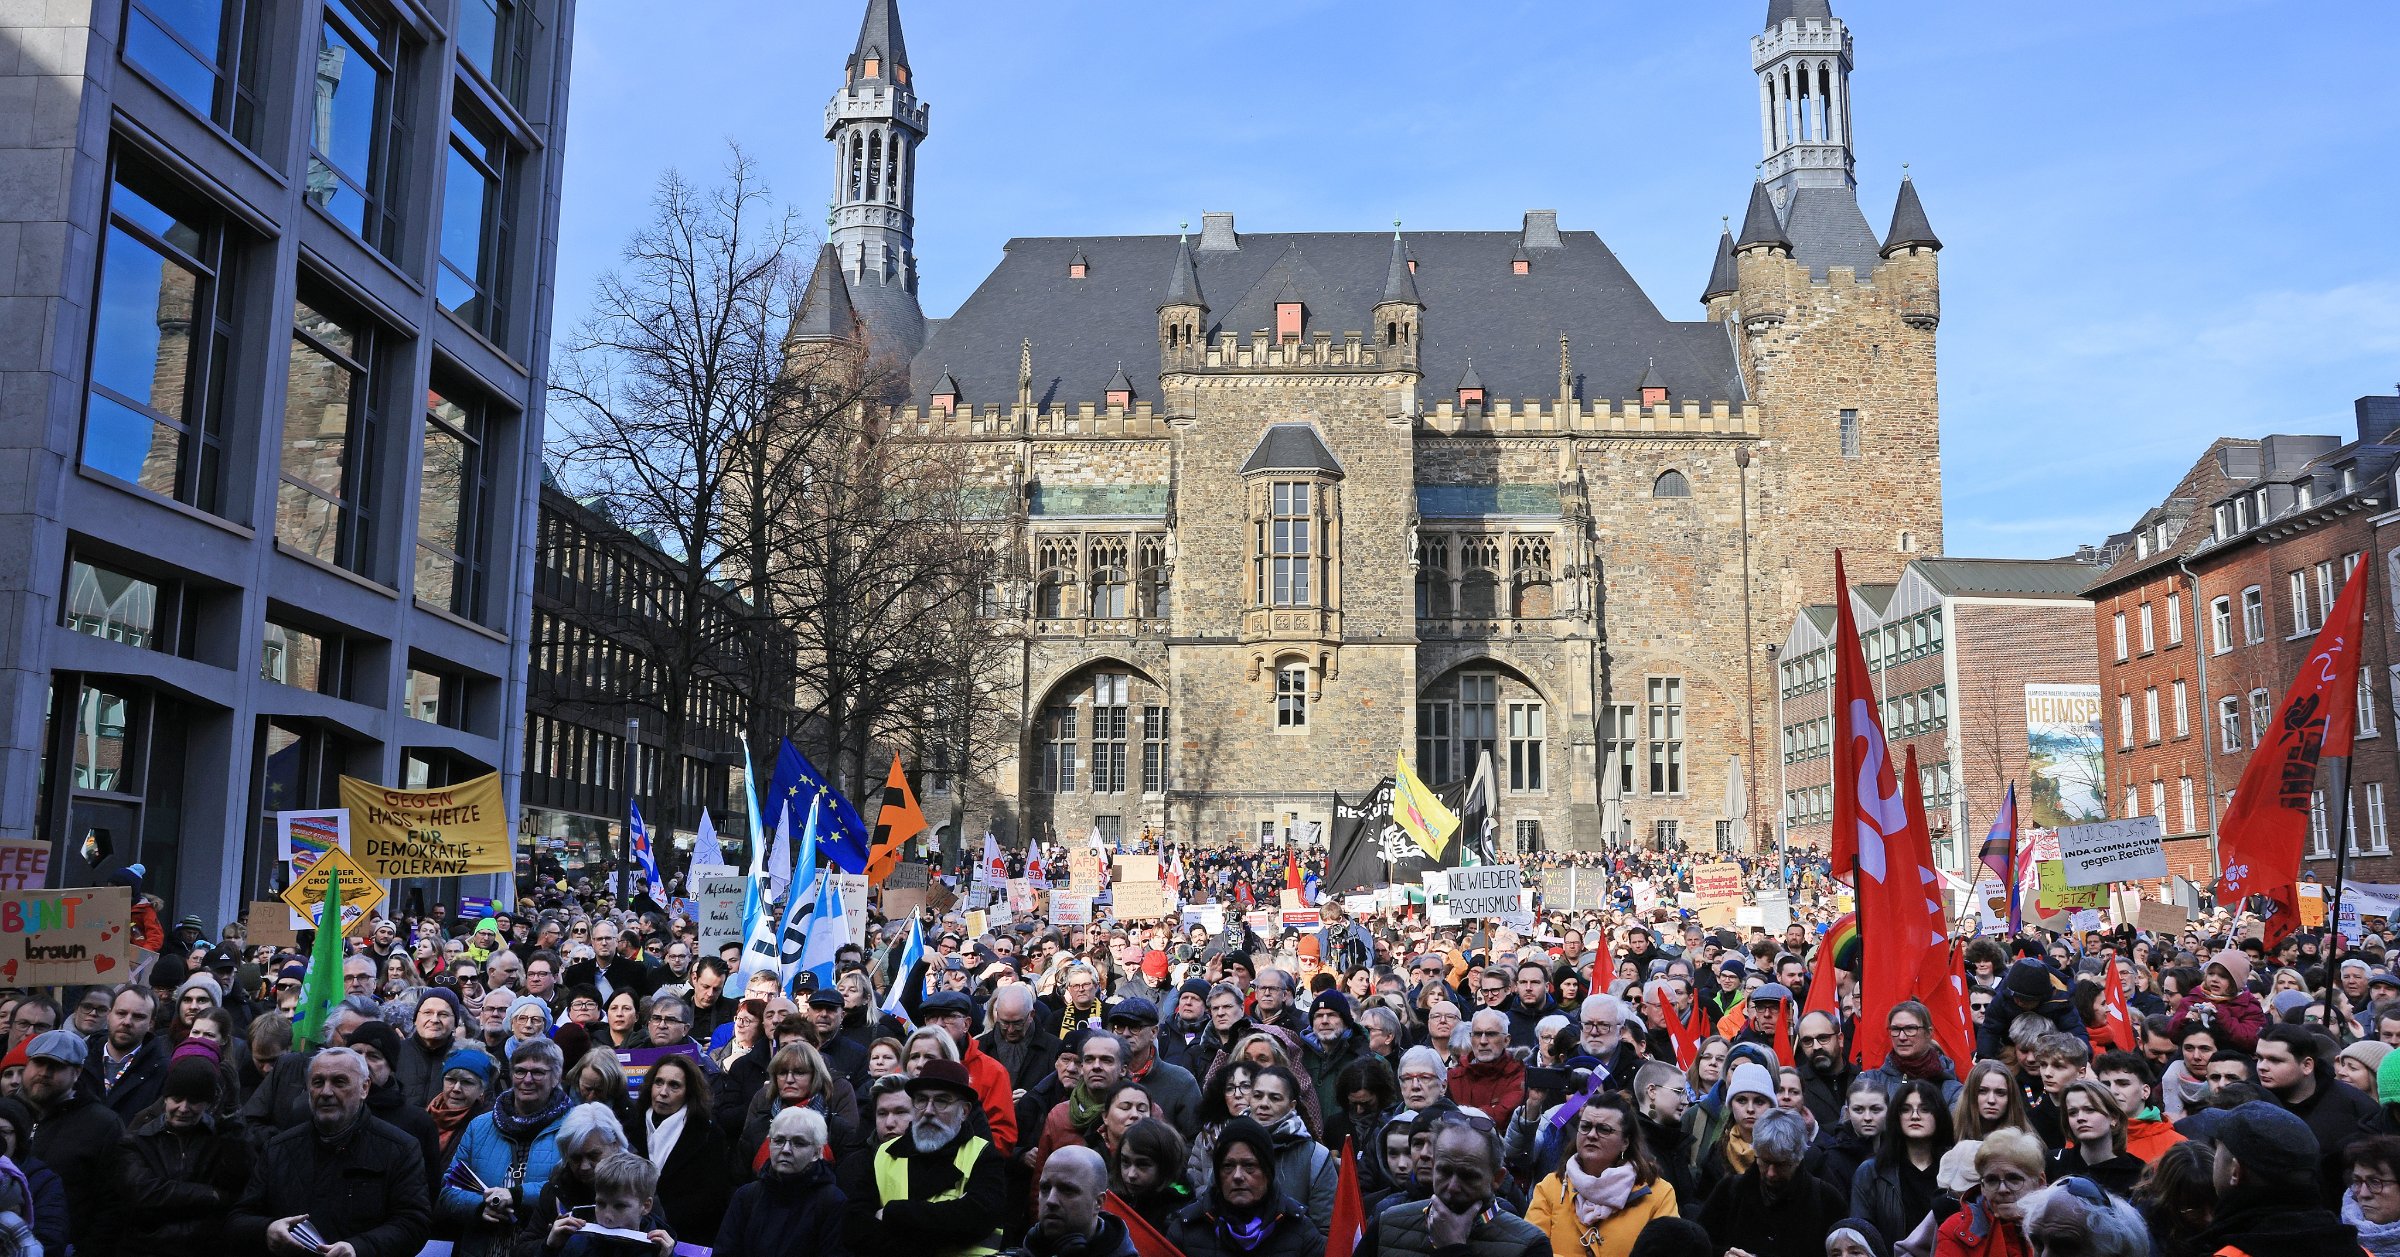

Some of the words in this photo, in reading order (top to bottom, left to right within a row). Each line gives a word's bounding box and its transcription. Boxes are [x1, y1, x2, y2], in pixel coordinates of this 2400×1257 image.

[384, 792, 453, 808] GEGEN
[368, 807, 413, 828] HASS
[416, 814, 426, 824] +
[430, 805, 480, 826] HETZE
[407, 828, 444, 844] FÜR
[366, 840, 471, 859] DEMOKRATIE
[2064, 838, 2160, 859] INDA-GYMNASIUM
[2080, 854, 2118, 870] gegen
[2118, 845, 2159, 860] Rechts!
[376, 860, 469, 876] TOLERANZ
[1074, 858, 1096, 868] AFD
[704, 883, 742, 898] Aufstehen
[1448, 872, 1466, 892] NIE
[1468, 870, 1518, 890] WIEDER
[1450, 894, 1521, 916] FASCHISMUS!
[2, 897, 83, 934] BUNT
[25, 937, 86, 960] braun
[800, 972, 810, 984] F
